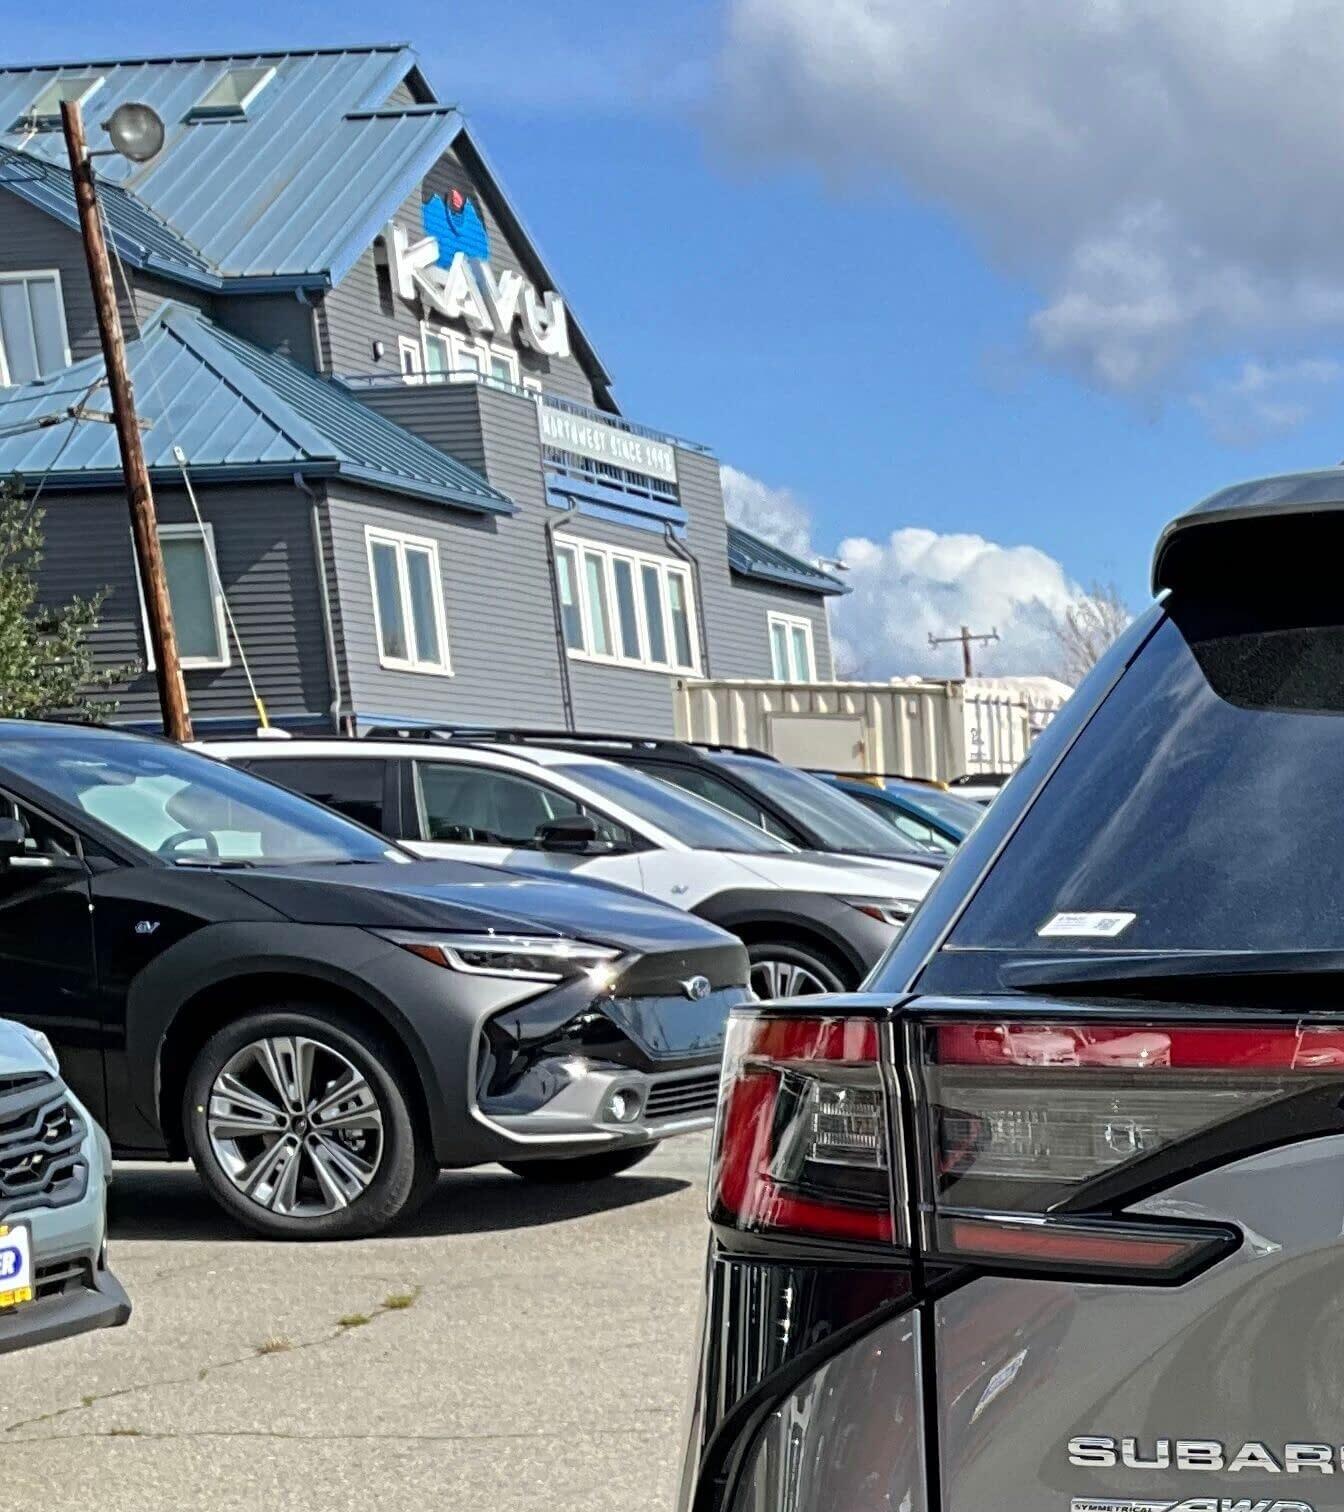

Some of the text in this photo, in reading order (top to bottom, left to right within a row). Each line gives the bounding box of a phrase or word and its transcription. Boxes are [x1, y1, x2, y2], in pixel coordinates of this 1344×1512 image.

[387, 219, 570, 358] KAVU
[542, 413, 606, 452] NORTHWEST
[610, 434, 643, 464] SINCE
